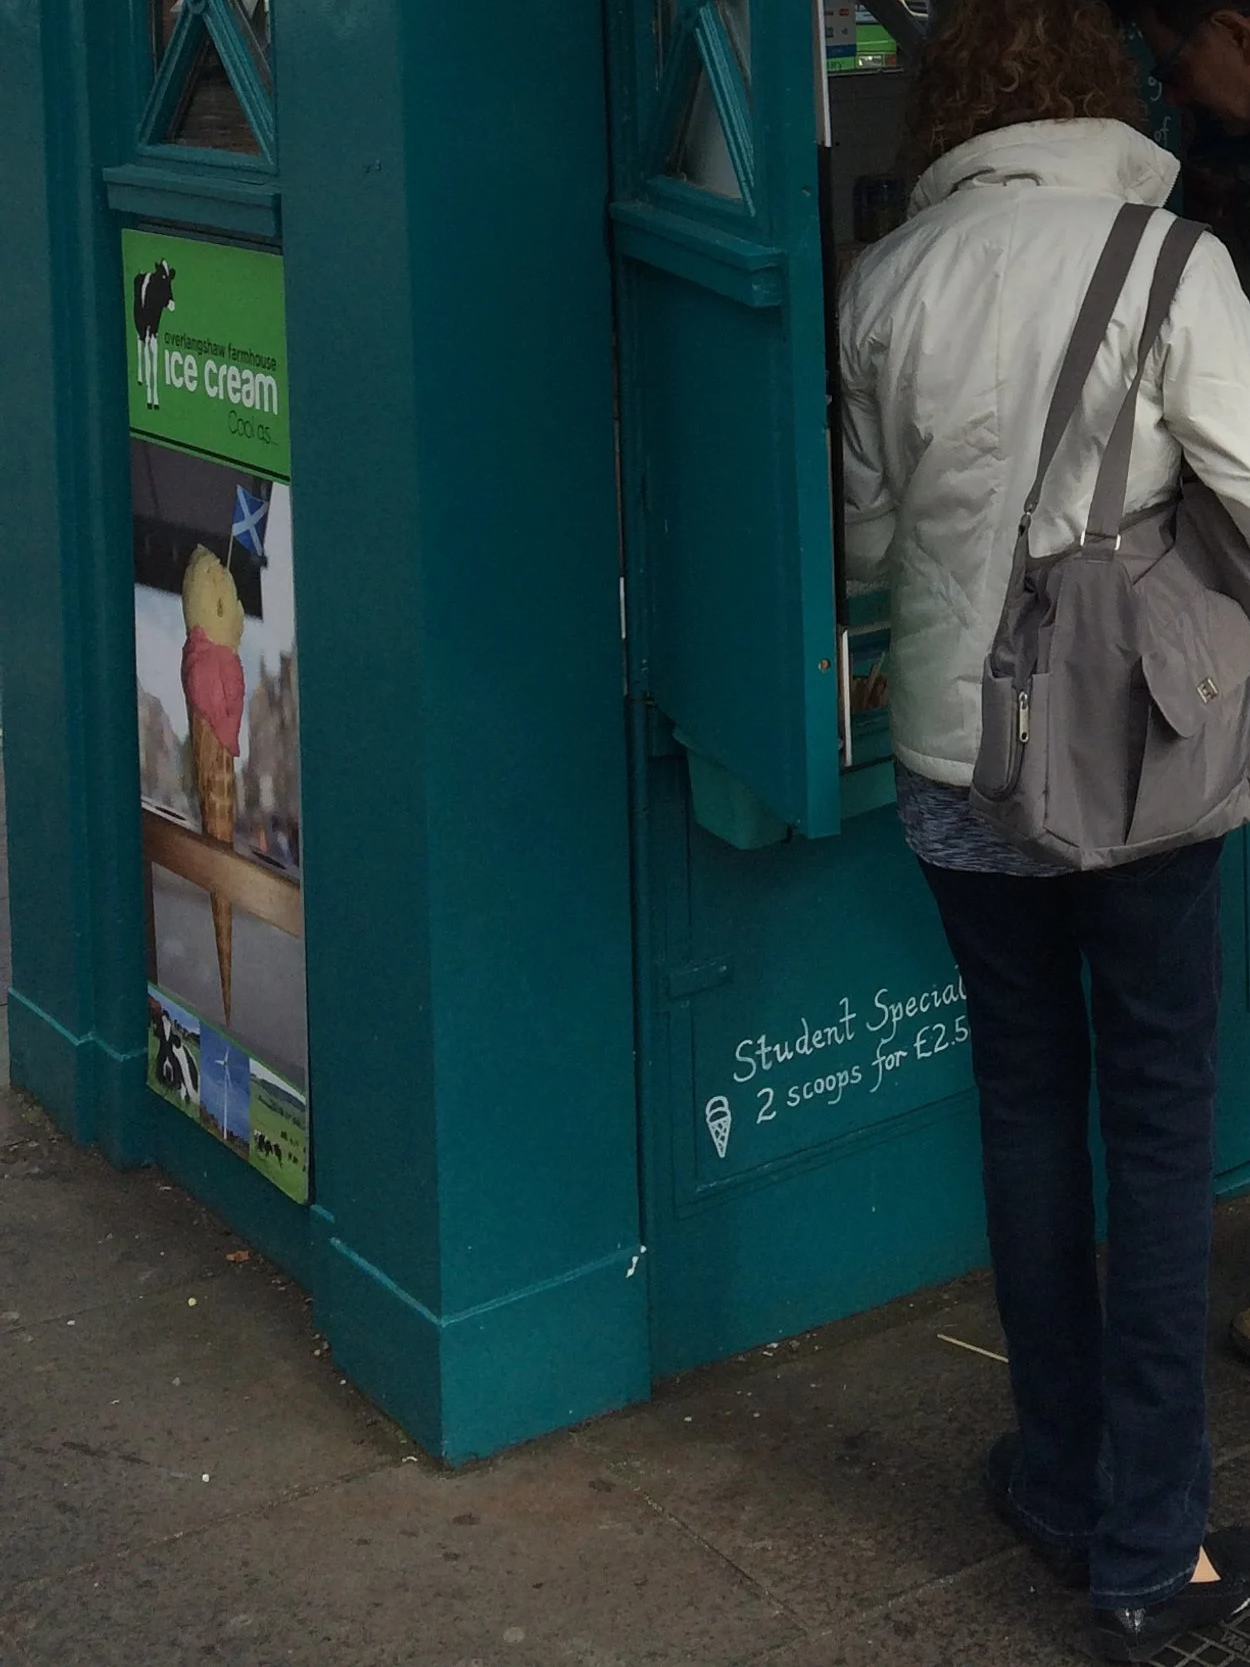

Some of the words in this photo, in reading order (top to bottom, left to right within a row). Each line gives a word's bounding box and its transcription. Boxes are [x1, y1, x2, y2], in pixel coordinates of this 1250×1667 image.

[164, 331, 226, 358] overlangshaw
[228, 342, 277, 372] farmhouse
[203, 358, 279, 416] cream
[227, 409, 255, 439] Cool
[733, 996, 857, 1083] Student
[866, 964, 968, 1042] Special
[755, 1086, 777, 1125] 2
[786, 1063, 862, 1106] scoops
[868, 1038, 909, 1094] for
[913, 1014, 972, 1060] £2.5
